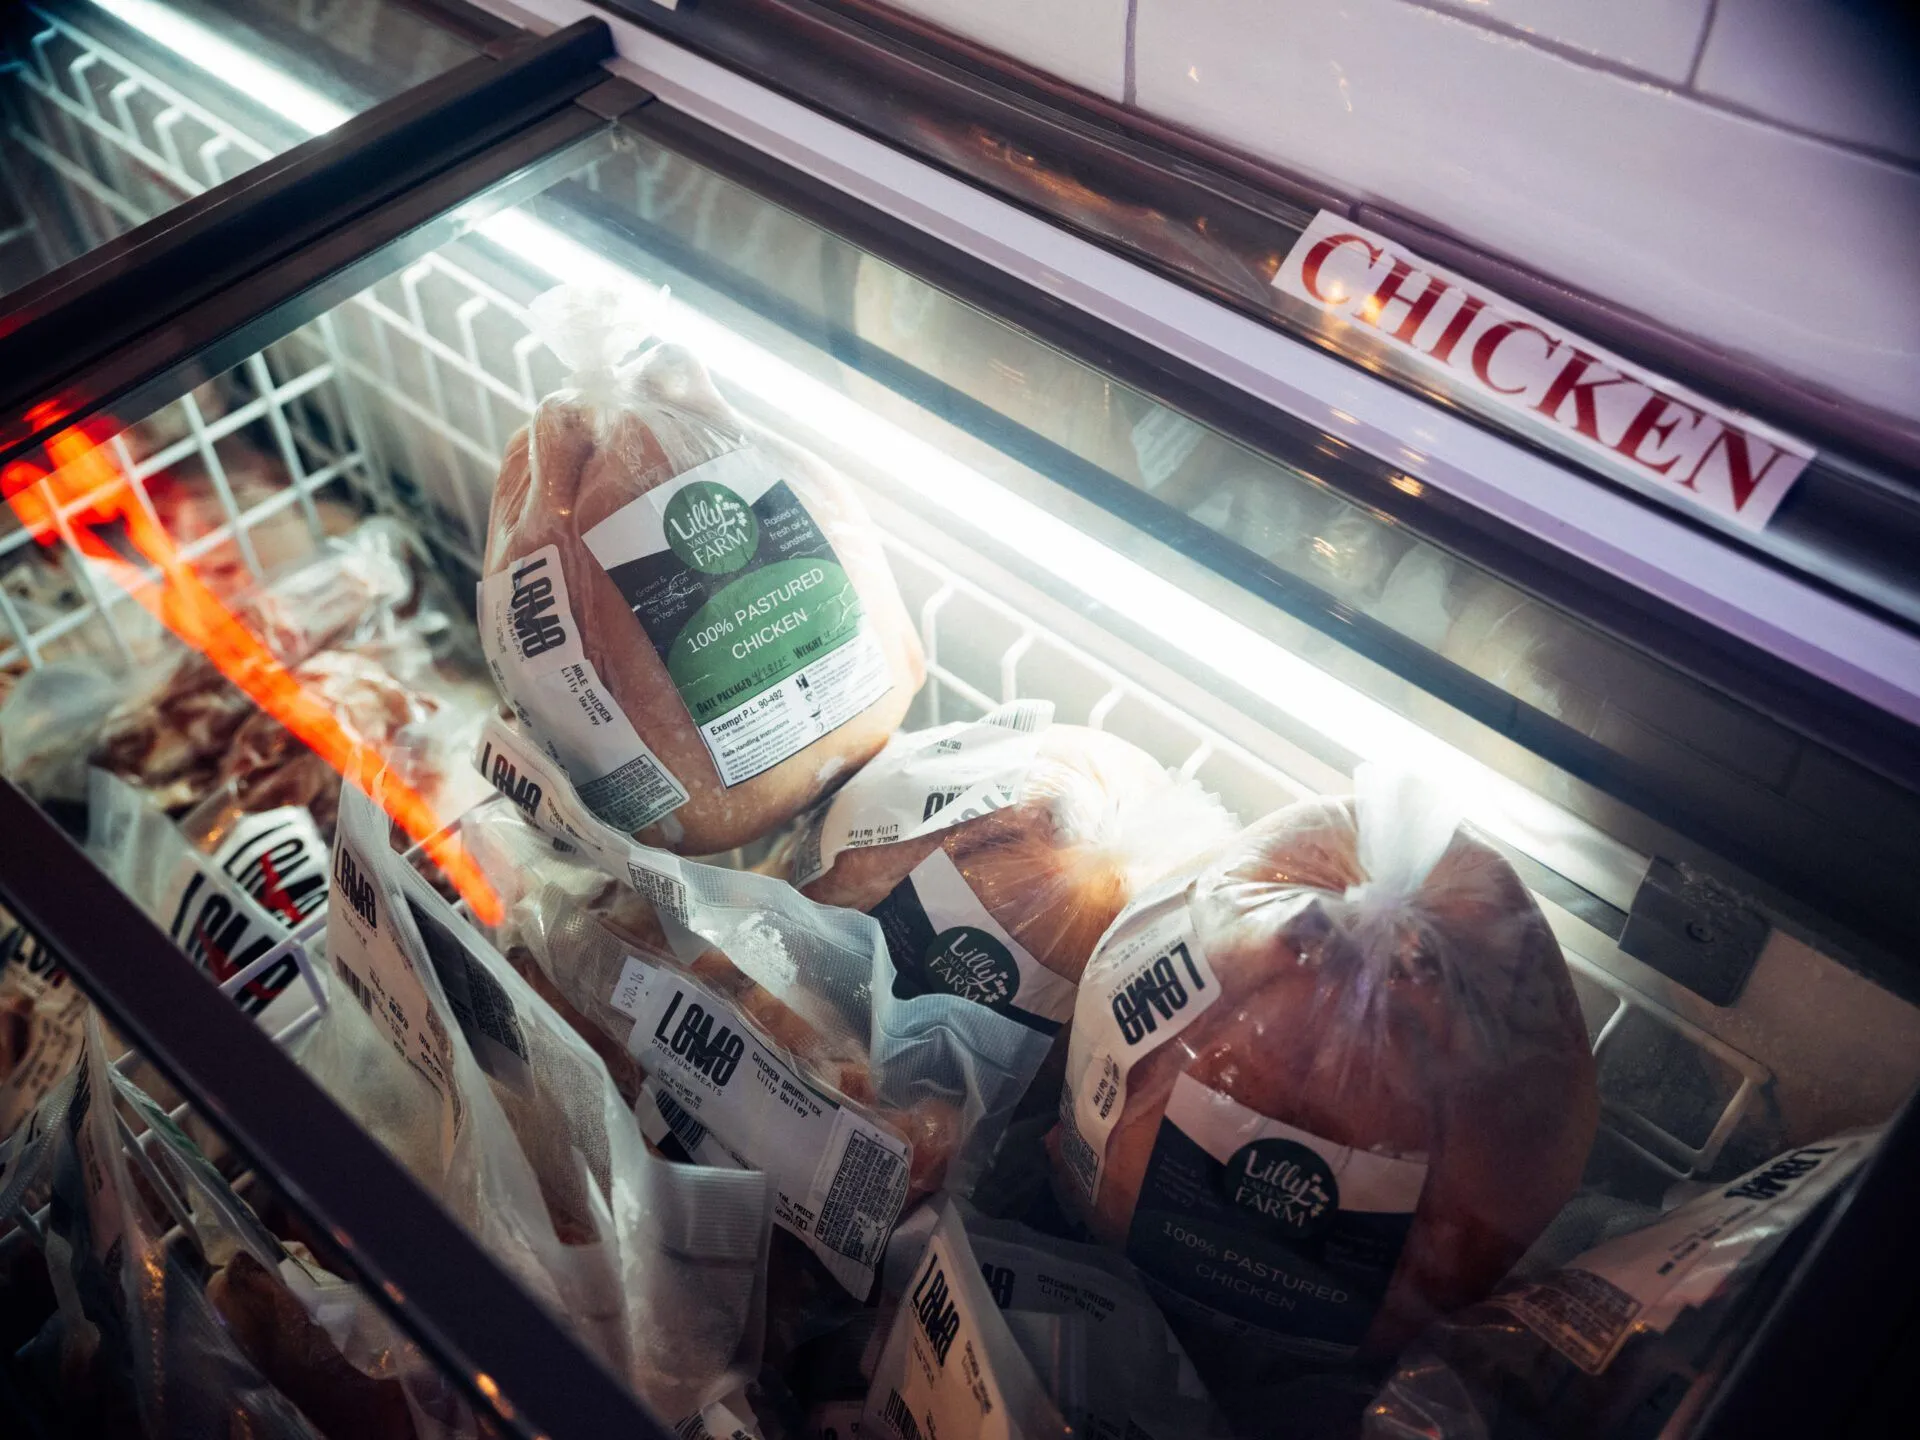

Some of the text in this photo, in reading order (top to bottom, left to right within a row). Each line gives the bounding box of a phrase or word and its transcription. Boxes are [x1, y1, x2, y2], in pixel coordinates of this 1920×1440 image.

[1302, 233, 1797, 513] CHICKEN
[670, 500, 736, 537] Lilly
[687, 529, 718, 549] VALLEY
[763, 510, 789, 527] Raised
[769, 525, 791, 541] fresh
[693, 528, 748, 567] FARM
[687, 568, 824, 653] 100% PASTURED
[732, 608, 808, 659] CHICKEN
[561, 667, 601, 727] Lilly Valley
[585, 688, 613, 723] CHICKEN
[710, 714, 742, 736] Exempt
[742, 706, 759, 719] P.L.
[758, 689, 784, 709] 90-492
[722, 748, 736, 759] Safe
[736, 737, 759, 752] Handling
[759, 720, 790, 739] Instructions
[877, 824, 899, 836] Lilly
[929, 955, 980, 1001] FARM
[949, 932, 998, 993] Lilly
[1106, 969, 1136, 1000] MEATS
[1111, 942, 1205, 1046] LOMO
[655, 990, 745, 1087] LOMO
[651, 1038, 694, 1076] PREMIUM
[694, 1070, 724, 1097] MEATS
[752, 1051, 822, 1118] CHICKEN DRUMSTICK
[756, 1070, 809, 1118] Lilly Valley
[820, 1187, 842, 1222] HANDLING
[832, 1137, 862, 1189] INSTRUCTIONS
[1245, 1149, 1312, 1208] Lilly
[792, 1203, 817, 1222] PRICE
[1235, 1185, 1306, 1227] FARM
[1163, 1221, 1218, 1257] 100%
[1223, 1250, 1349, 1303] PASTURED
[1195, 1263, 1297, 1312] CHICKEN
